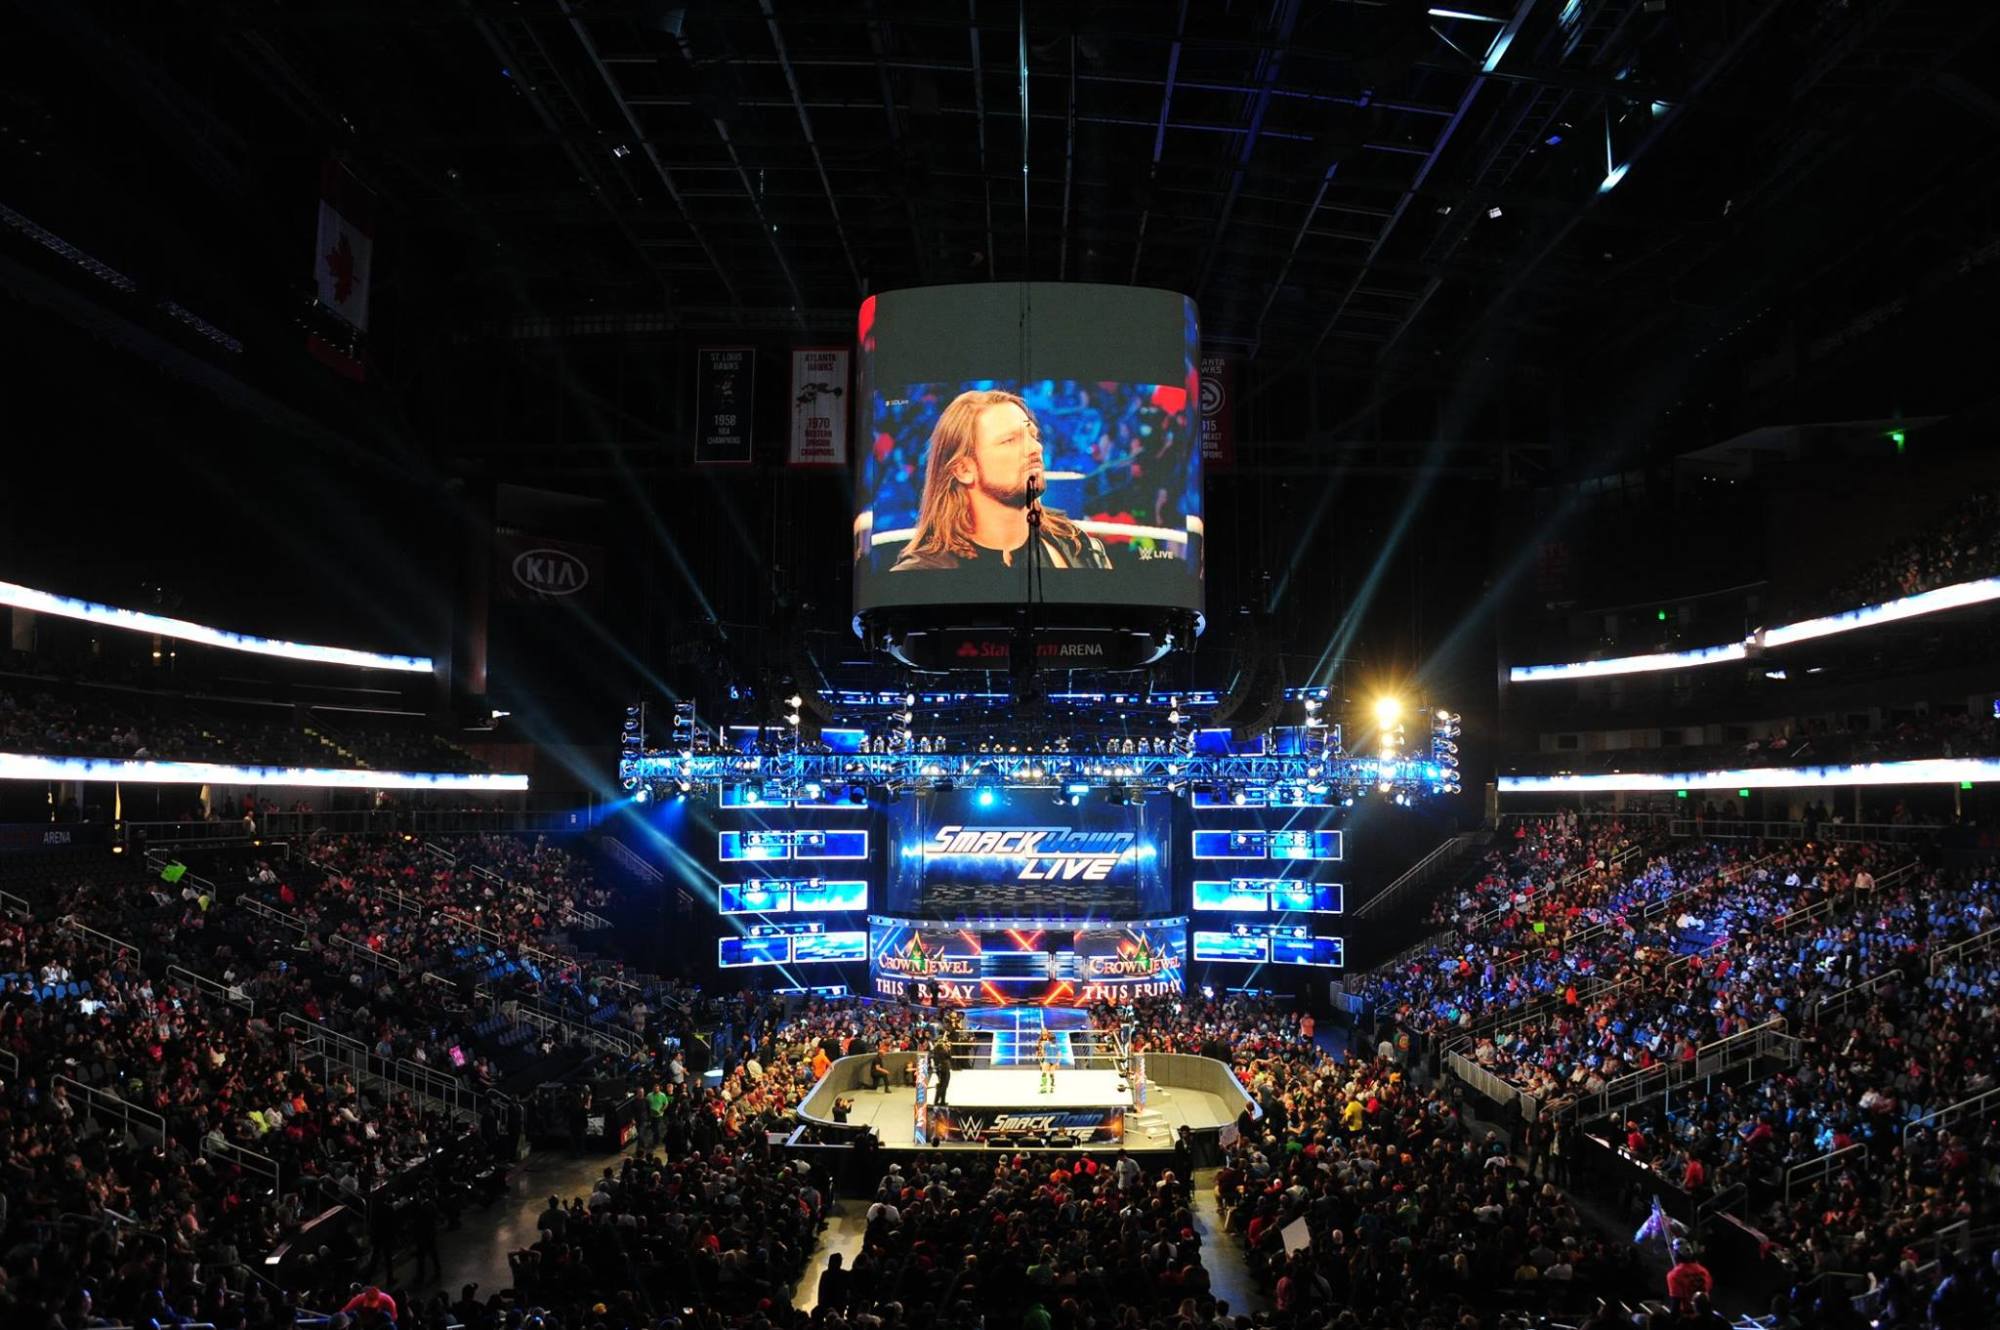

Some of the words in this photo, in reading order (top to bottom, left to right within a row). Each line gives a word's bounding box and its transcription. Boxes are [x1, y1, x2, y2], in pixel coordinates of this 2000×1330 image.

[805, 354, 836, 362] ATLANTA
[714, 414, 736, 426] 1958
[808, 418, 830, 428] 1970
[1154, 551, 1174, 559] LIVE
[526, 557, 577, 586] KIA
[1060, 643, 1103, 656] ARENA
[43, 831, 71, 844] ARENA
[1018, 858, 1118, 880] LIVE
[879, 952, 920, 972] CROWN
[922, 958, 974, 974] JEWEL
[1089, 957, 1146, 974] CROWN
[1147, 955, 1181, 974] JEWEL
[876, 978, 904, 996] THIS
[1082, 984, 1128, 1000] THIS
